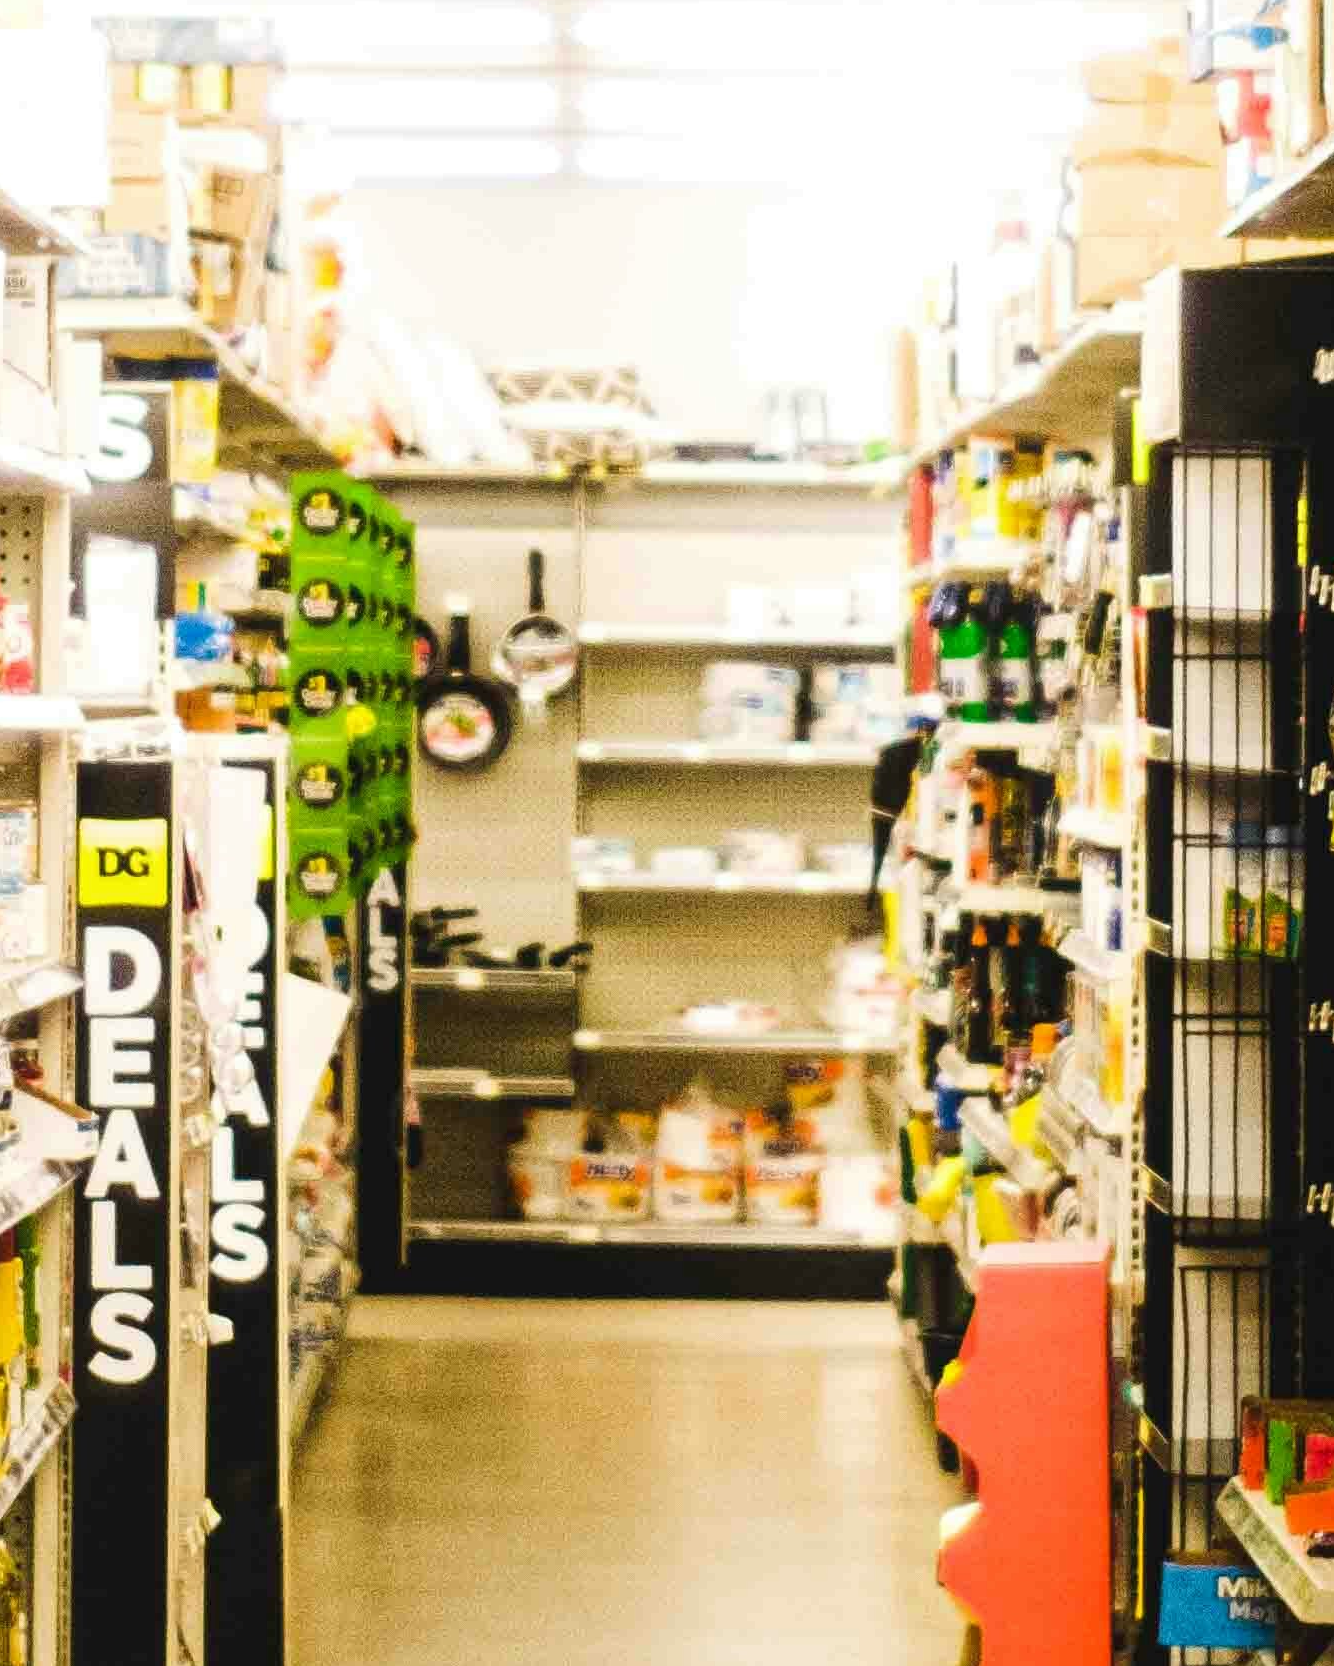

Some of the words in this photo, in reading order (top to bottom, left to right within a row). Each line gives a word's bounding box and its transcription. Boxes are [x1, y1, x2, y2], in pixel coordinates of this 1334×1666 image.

[98, 849, 150, 879] DG
[367, 867, 400, 993] ALS
[83, 925, 162, 1385] DEALS
